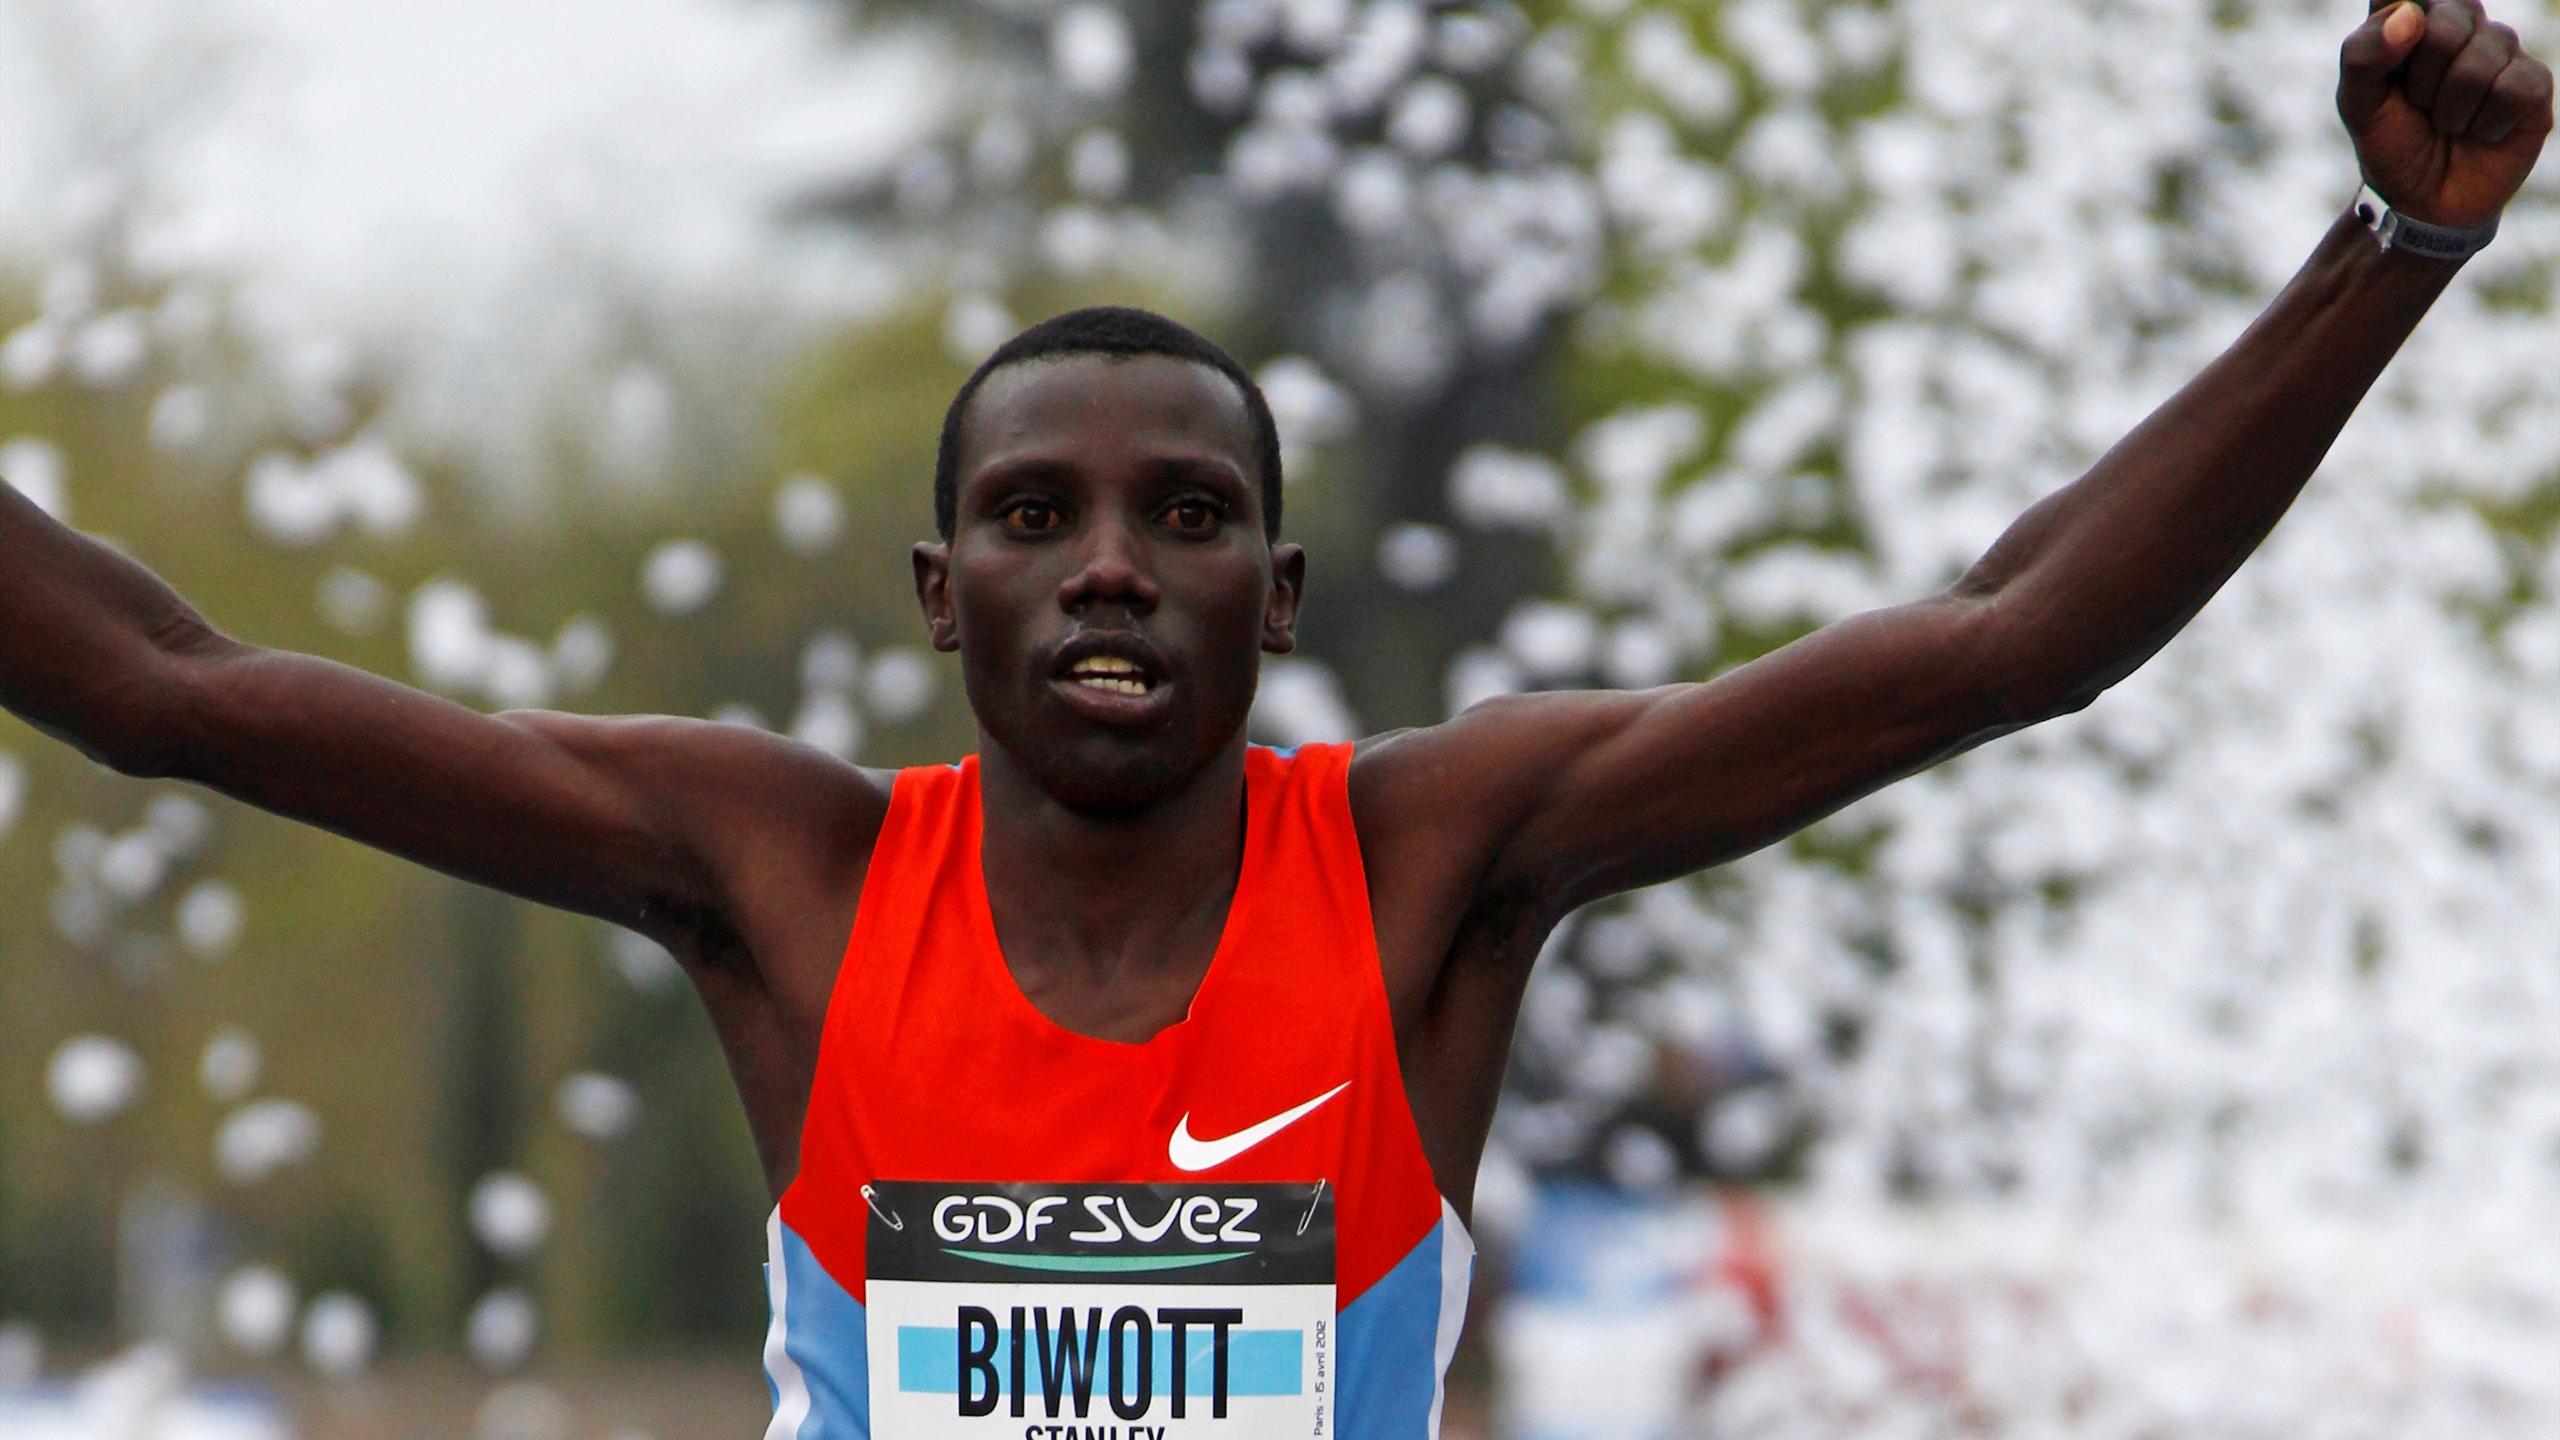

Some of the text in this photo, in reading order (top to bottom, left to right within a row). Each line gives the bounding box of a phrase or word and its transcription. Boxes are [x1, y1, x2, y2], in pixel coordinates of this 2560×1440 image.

[932, 1195, 1068, 1243] GDF
[1315, 1320, 1326, 1349] 2012
[957, 1305, 1243, 1420] BIWOTT
[1315, 1352, 1325, 1378] avril
[1313, 1405, 1324, 1436] Paris
